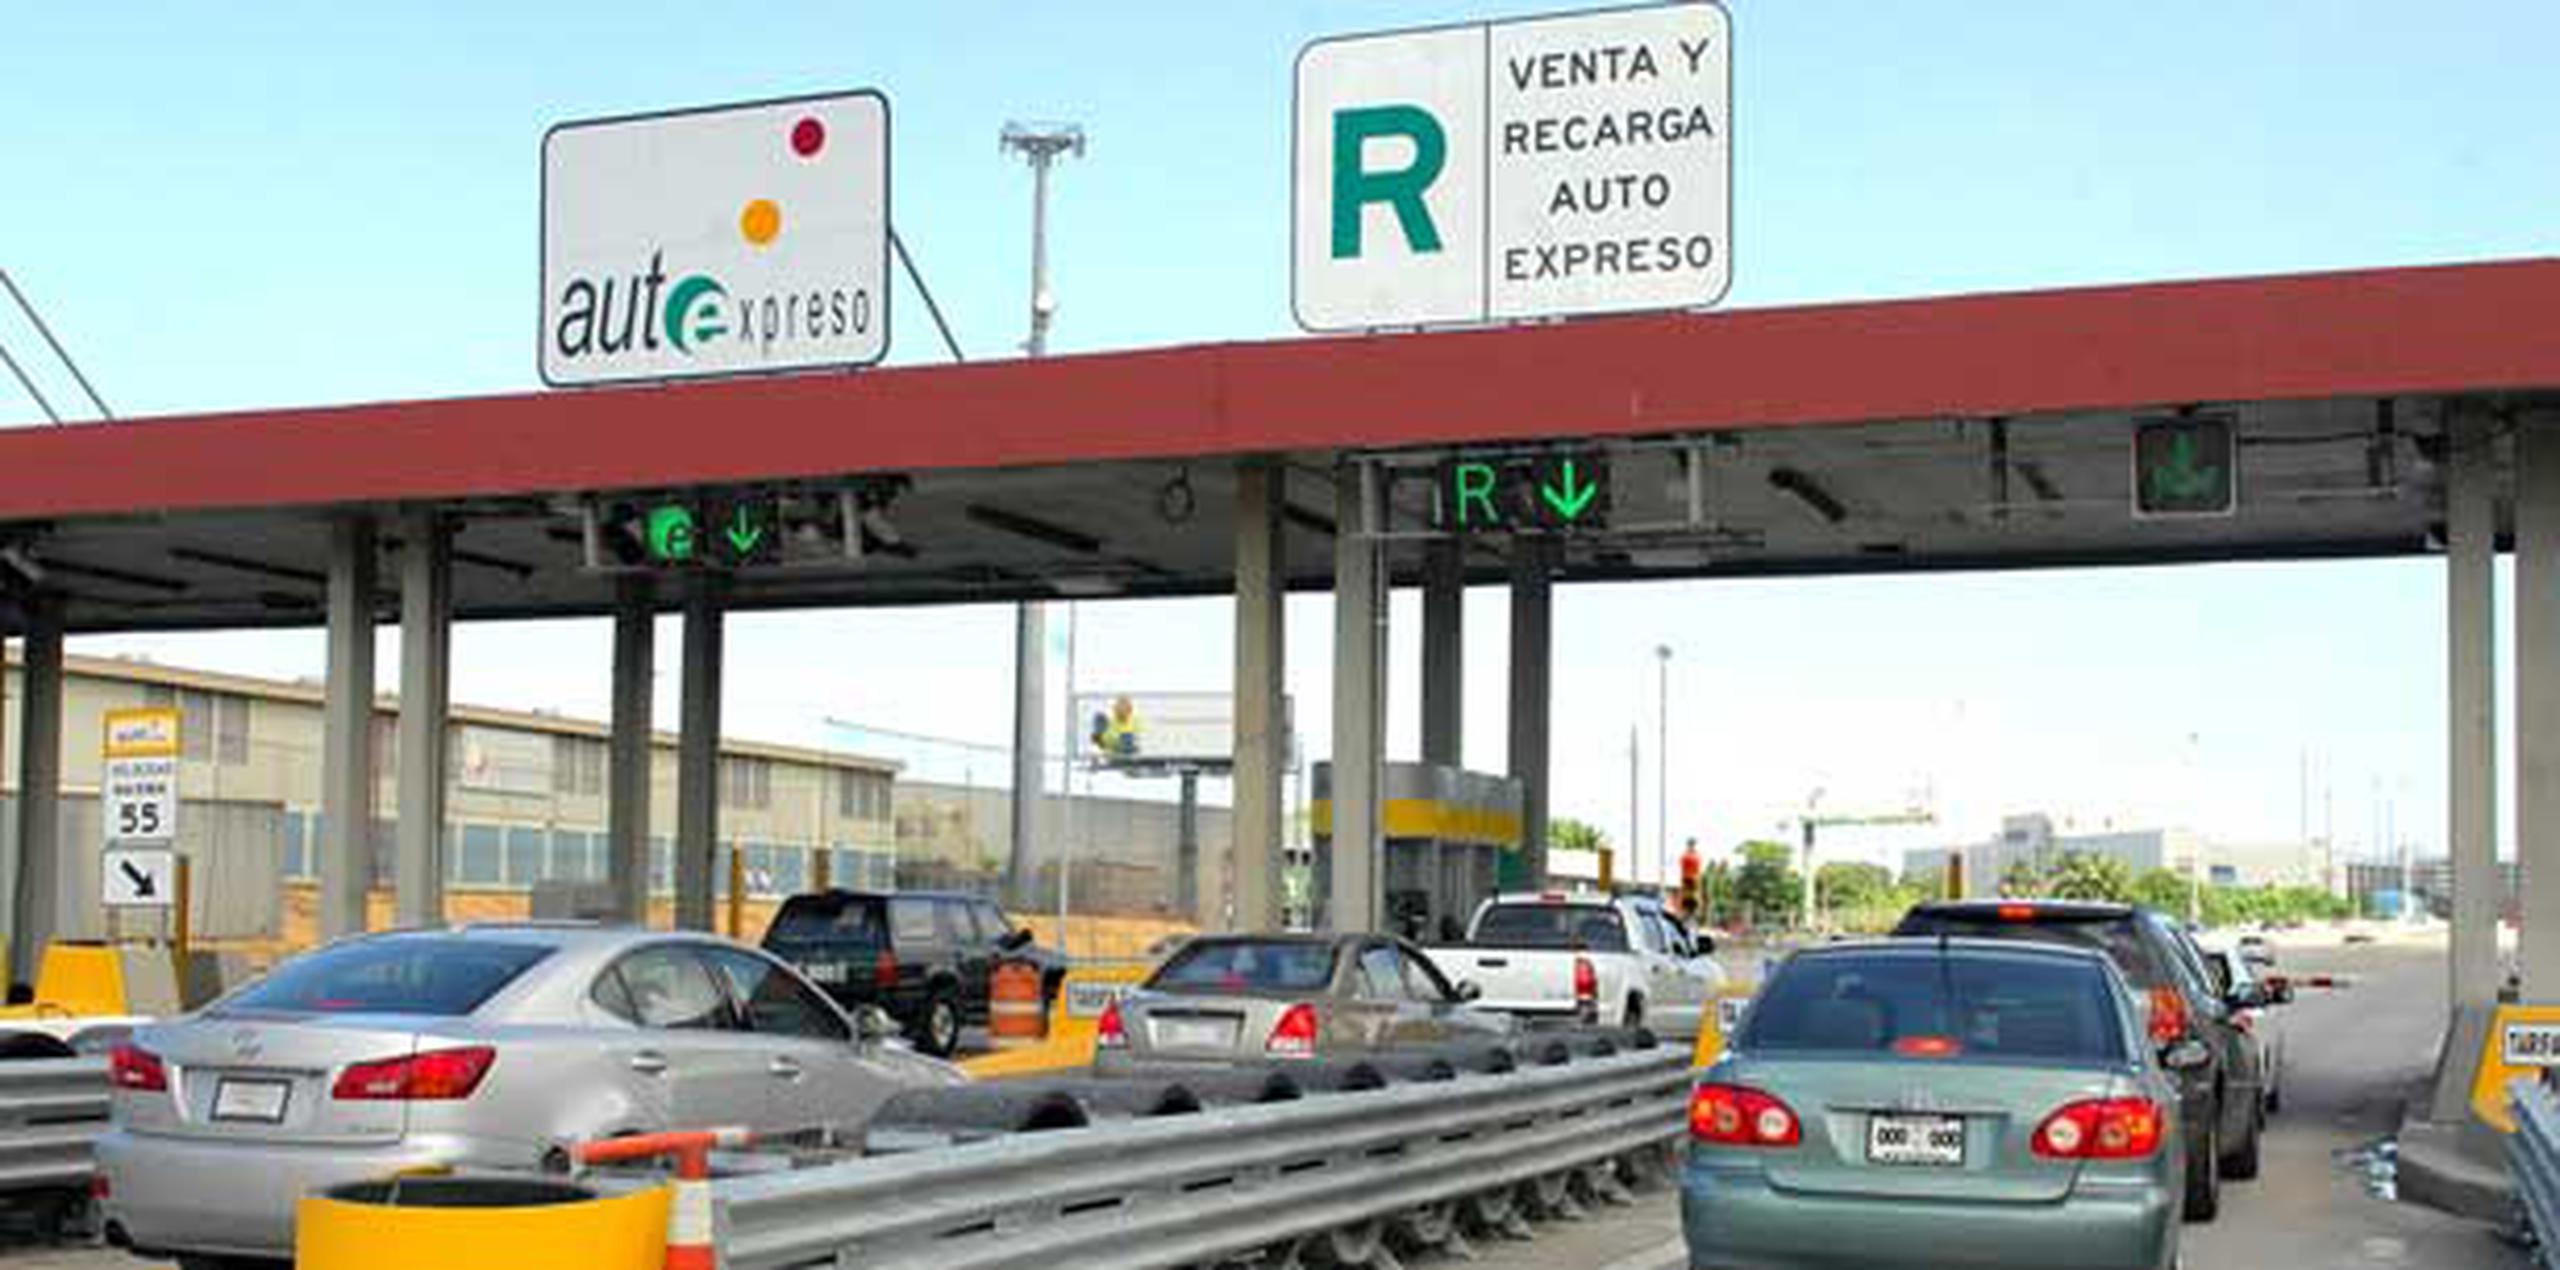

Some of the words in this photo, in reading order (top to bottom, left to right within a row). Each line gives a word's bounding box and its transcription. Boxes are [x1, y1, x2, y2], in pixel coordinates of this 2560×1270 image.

[1509, 46, 1658, 91] VENTA
[1680, 38, 1709, 75] Y
[1504, 107, 1714, 155] RECARGA
[1331, 104, 1447, 260] R
[1549, 174, 1671, 215] AUTO
[1505, 237, 1714, 281] EXPRESO
[1456, 463, 1498, 523] R
[120, 802, 160, 834] 55
